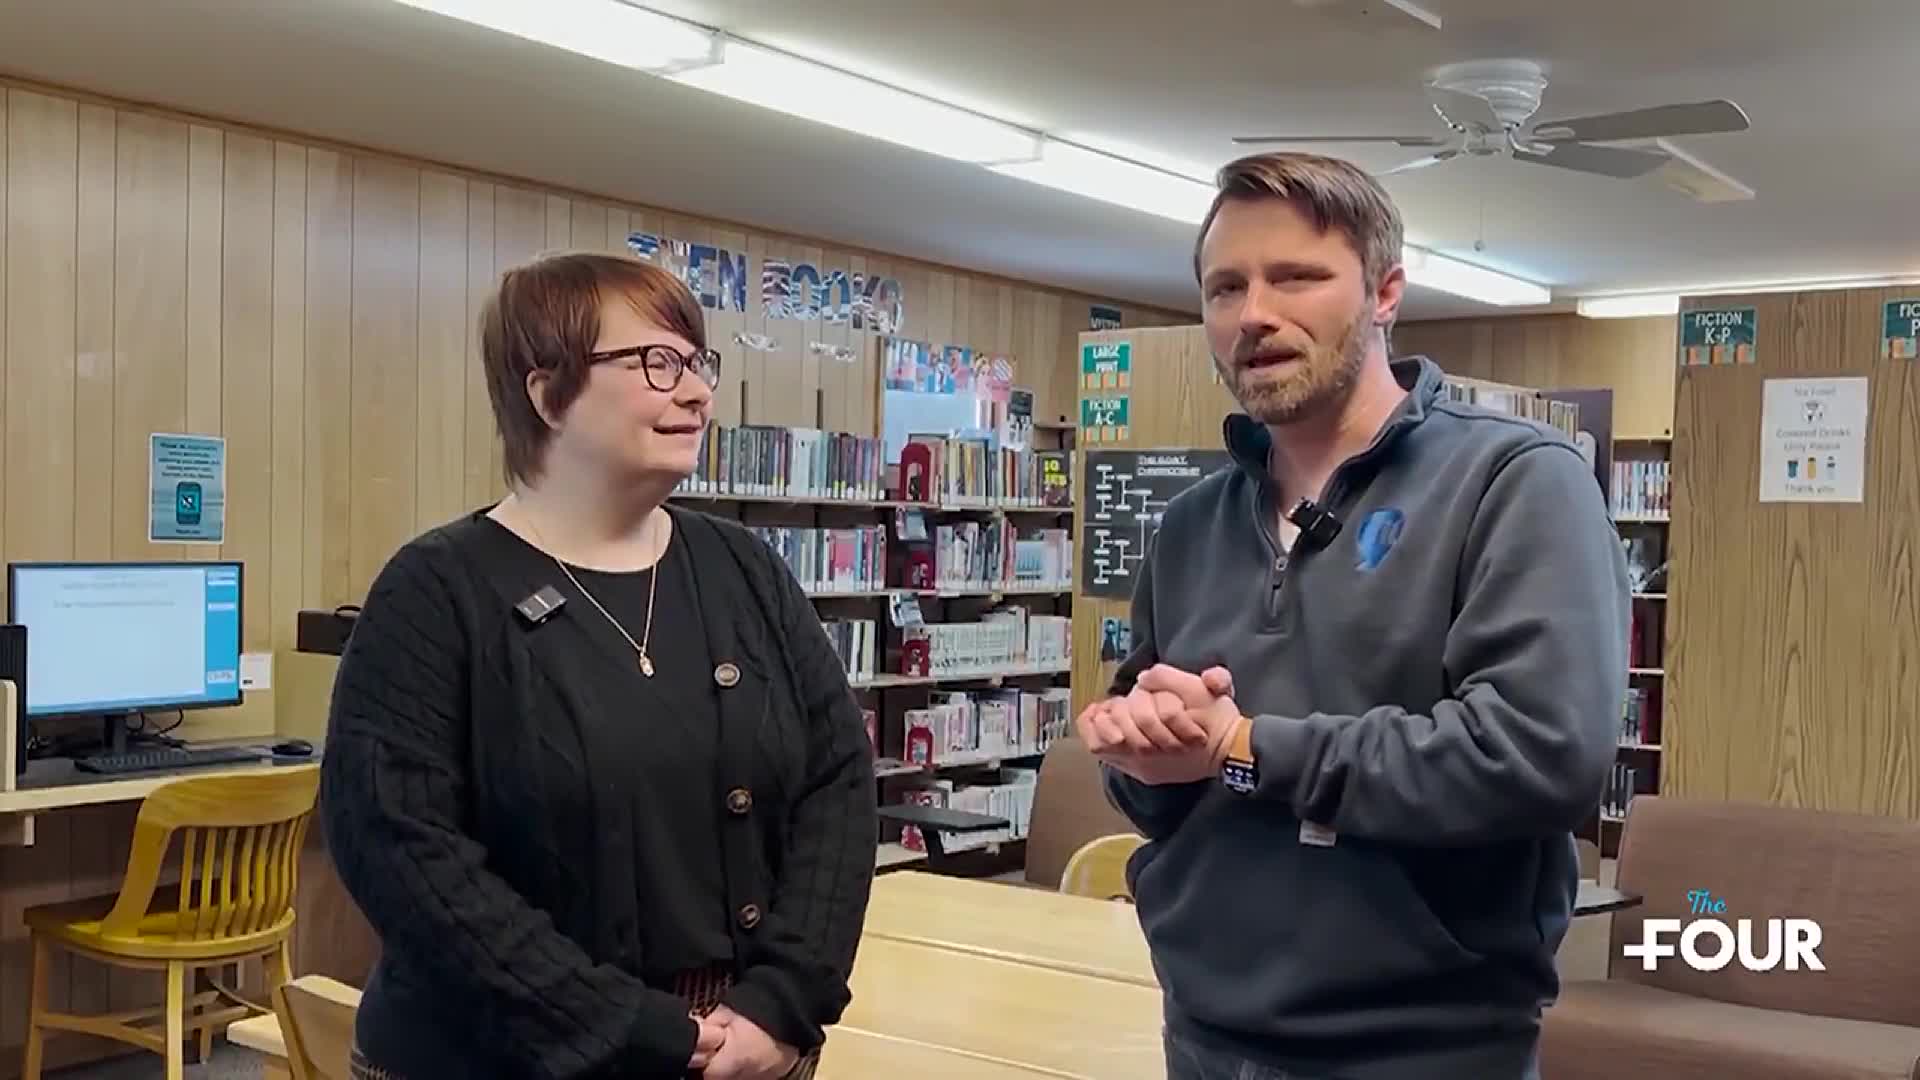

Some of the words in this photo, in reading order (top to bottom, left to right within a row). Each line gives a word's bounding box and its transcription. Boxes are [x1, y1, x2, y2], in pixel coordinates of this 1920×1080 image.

[761, 254, 904, 335] BOOKS
[1695, 312, 1743, 327] FICTION
[1704, 328, 1731, 344] K-P
[1095, 411, 1115, 425] A-C
